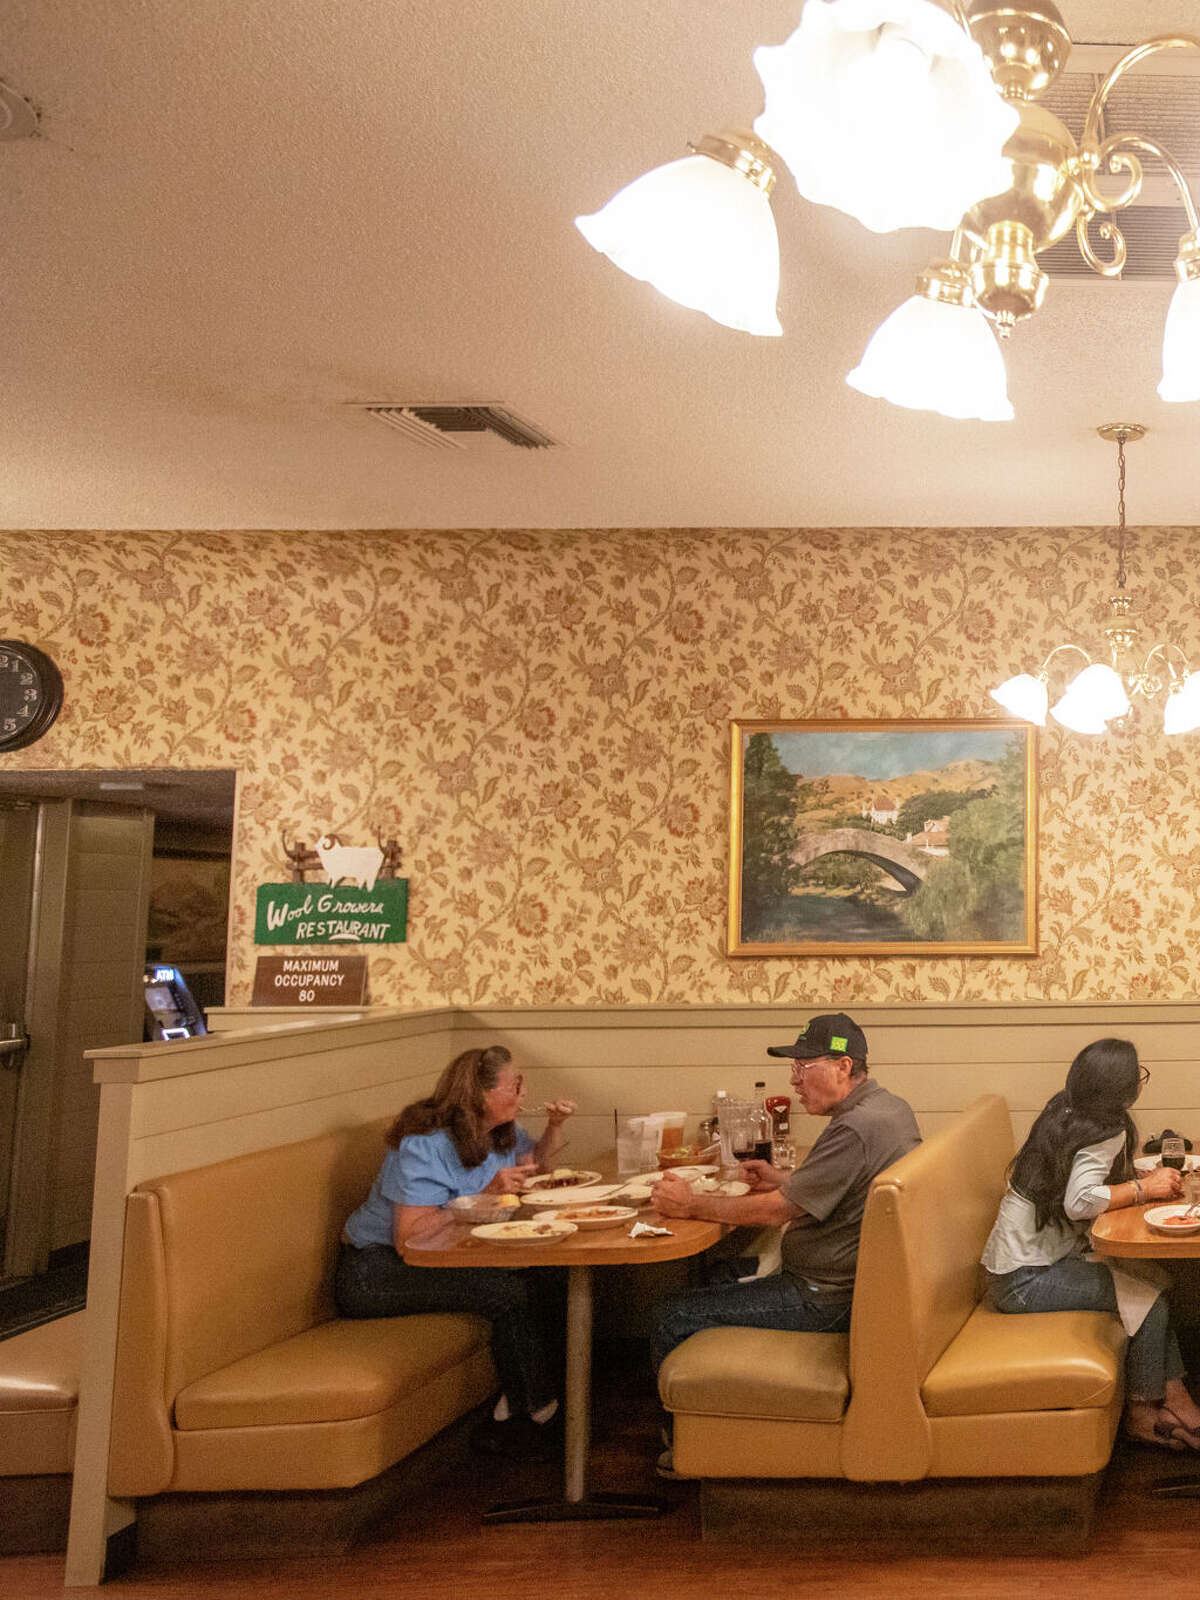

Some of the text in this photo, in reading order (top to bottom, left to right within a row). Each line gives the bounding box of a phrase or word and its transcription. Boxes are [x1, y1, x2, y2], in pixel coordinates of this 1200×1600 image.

[12, 660, 19, 673] 1
[20, 673, 33, 686] 2
[24, 689, 37, 702] 3
[16, 704, 30, 717] 4
[4, 718, 17, 731] 5
[267, 894, 384, 931] Wool Growers
[296, 920, 391, 940] RESTAURANT
[283, 960, 339, 972] MAXIMUM
[157, 969, 174, 982] ATM
[274, 974, 345, 987] OCCUPANCY
[299, 989, 315, 1002] 80
